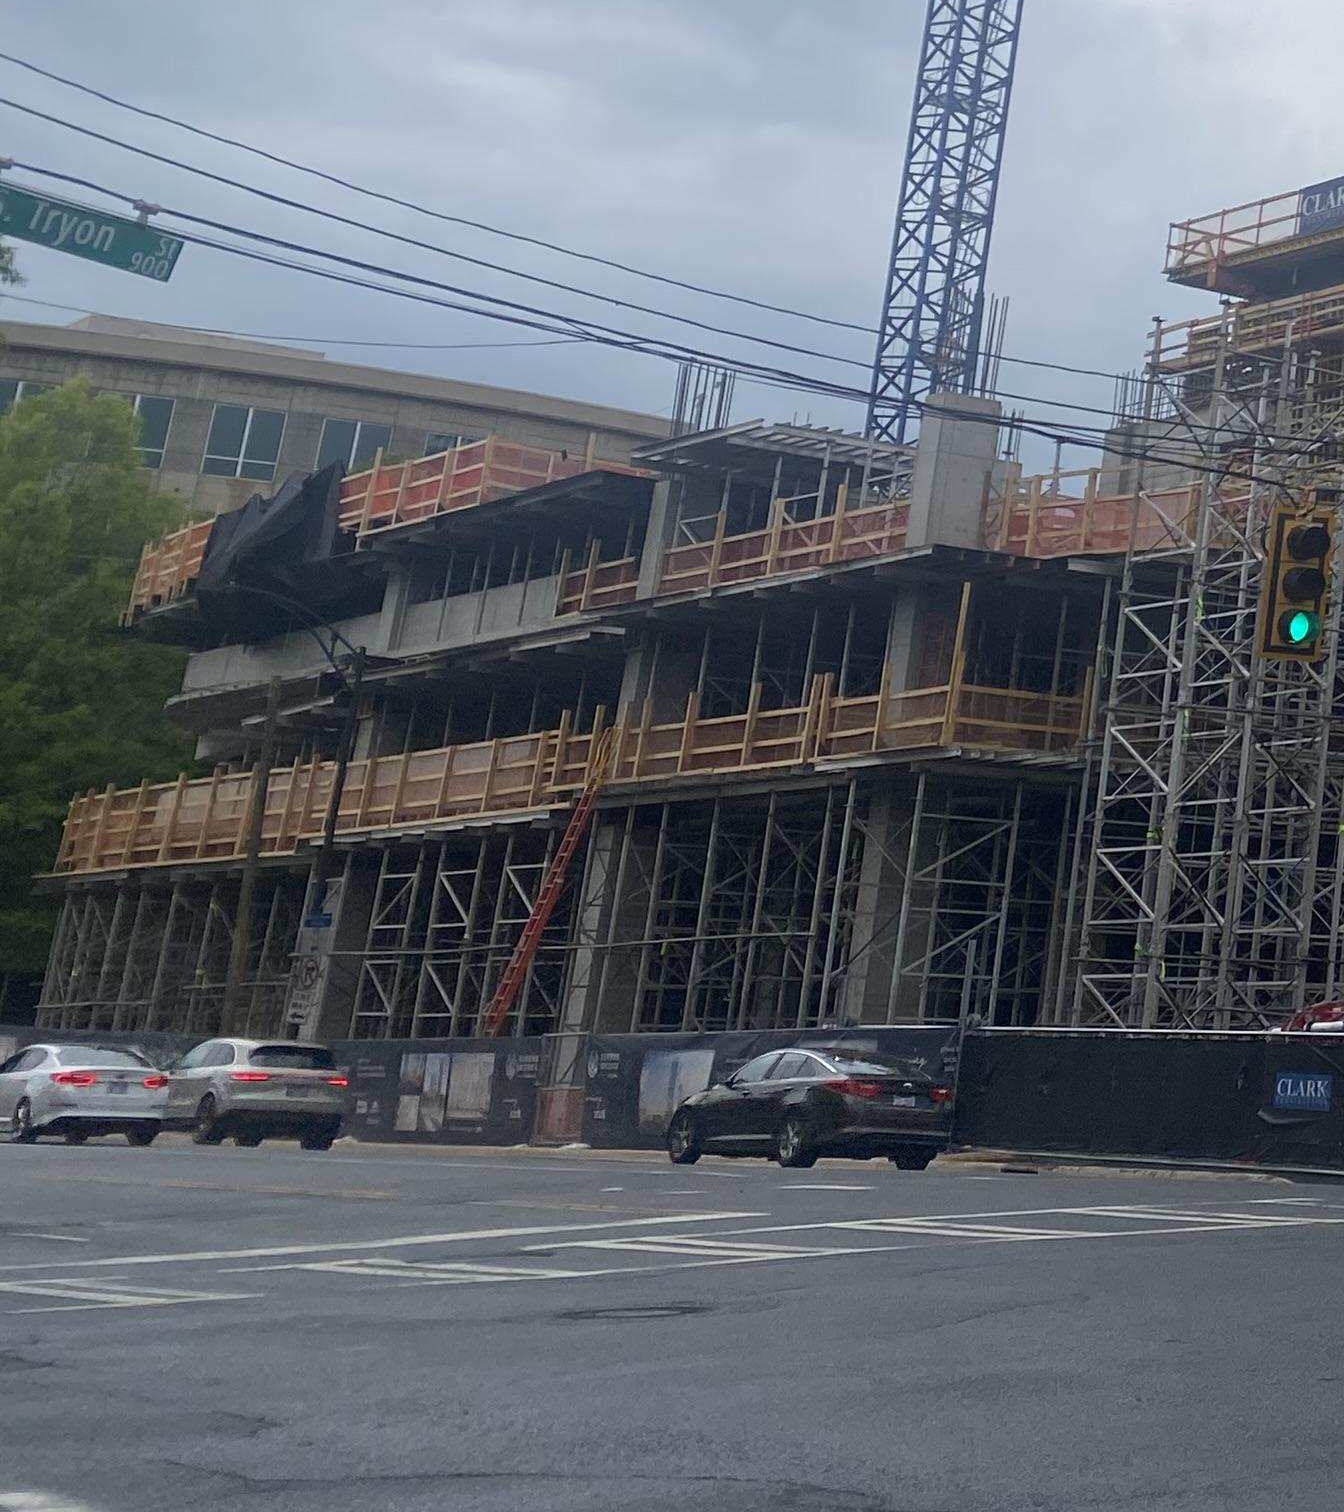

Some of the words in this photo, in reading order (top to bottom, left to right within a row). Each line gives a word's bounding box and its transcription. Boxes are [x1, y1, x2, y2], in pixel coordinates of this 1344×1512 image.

[28, 200, 116, 252] Tryon
[154, 237, 177, 259] St
[128, 251, 169, 278] 900
[1276, 1078, 1329, 1098] CLARK
